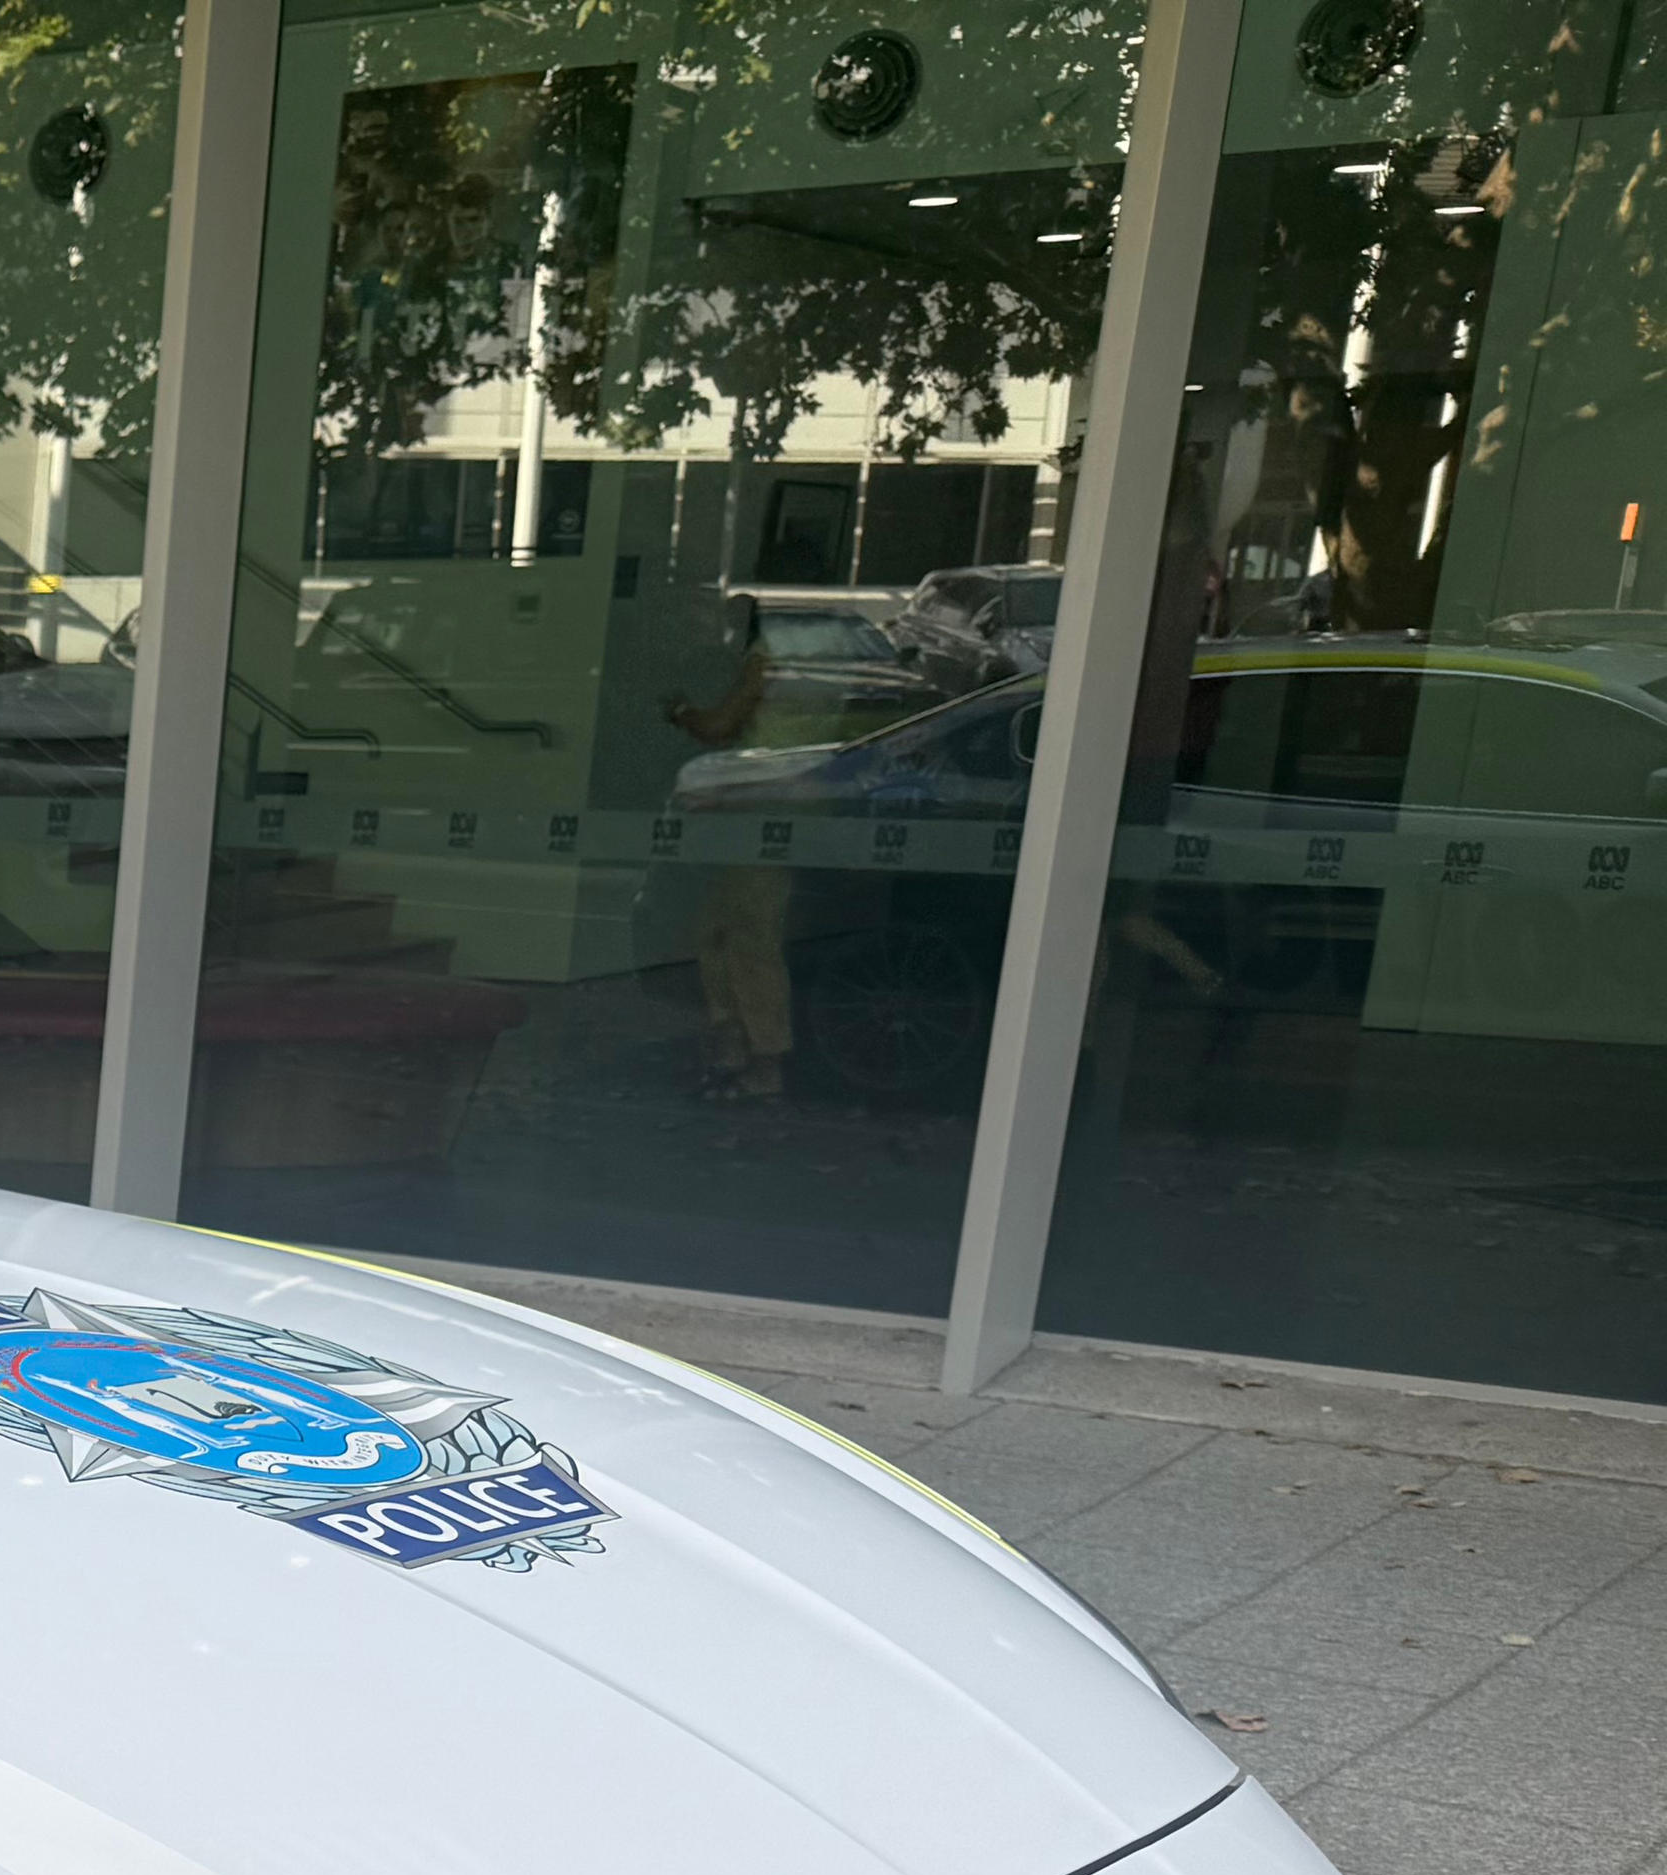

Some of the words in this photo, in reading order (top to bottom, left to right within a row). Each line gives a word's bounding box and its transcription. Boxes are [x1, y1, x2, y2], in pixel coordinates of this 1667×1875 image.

[1304, 865, 1339, 879] ABC
[1440, 870, 1479, 884] ABC
[1583, 875, 1625, 890] ABC
[317, 1474, 590, 1557] POLICE
